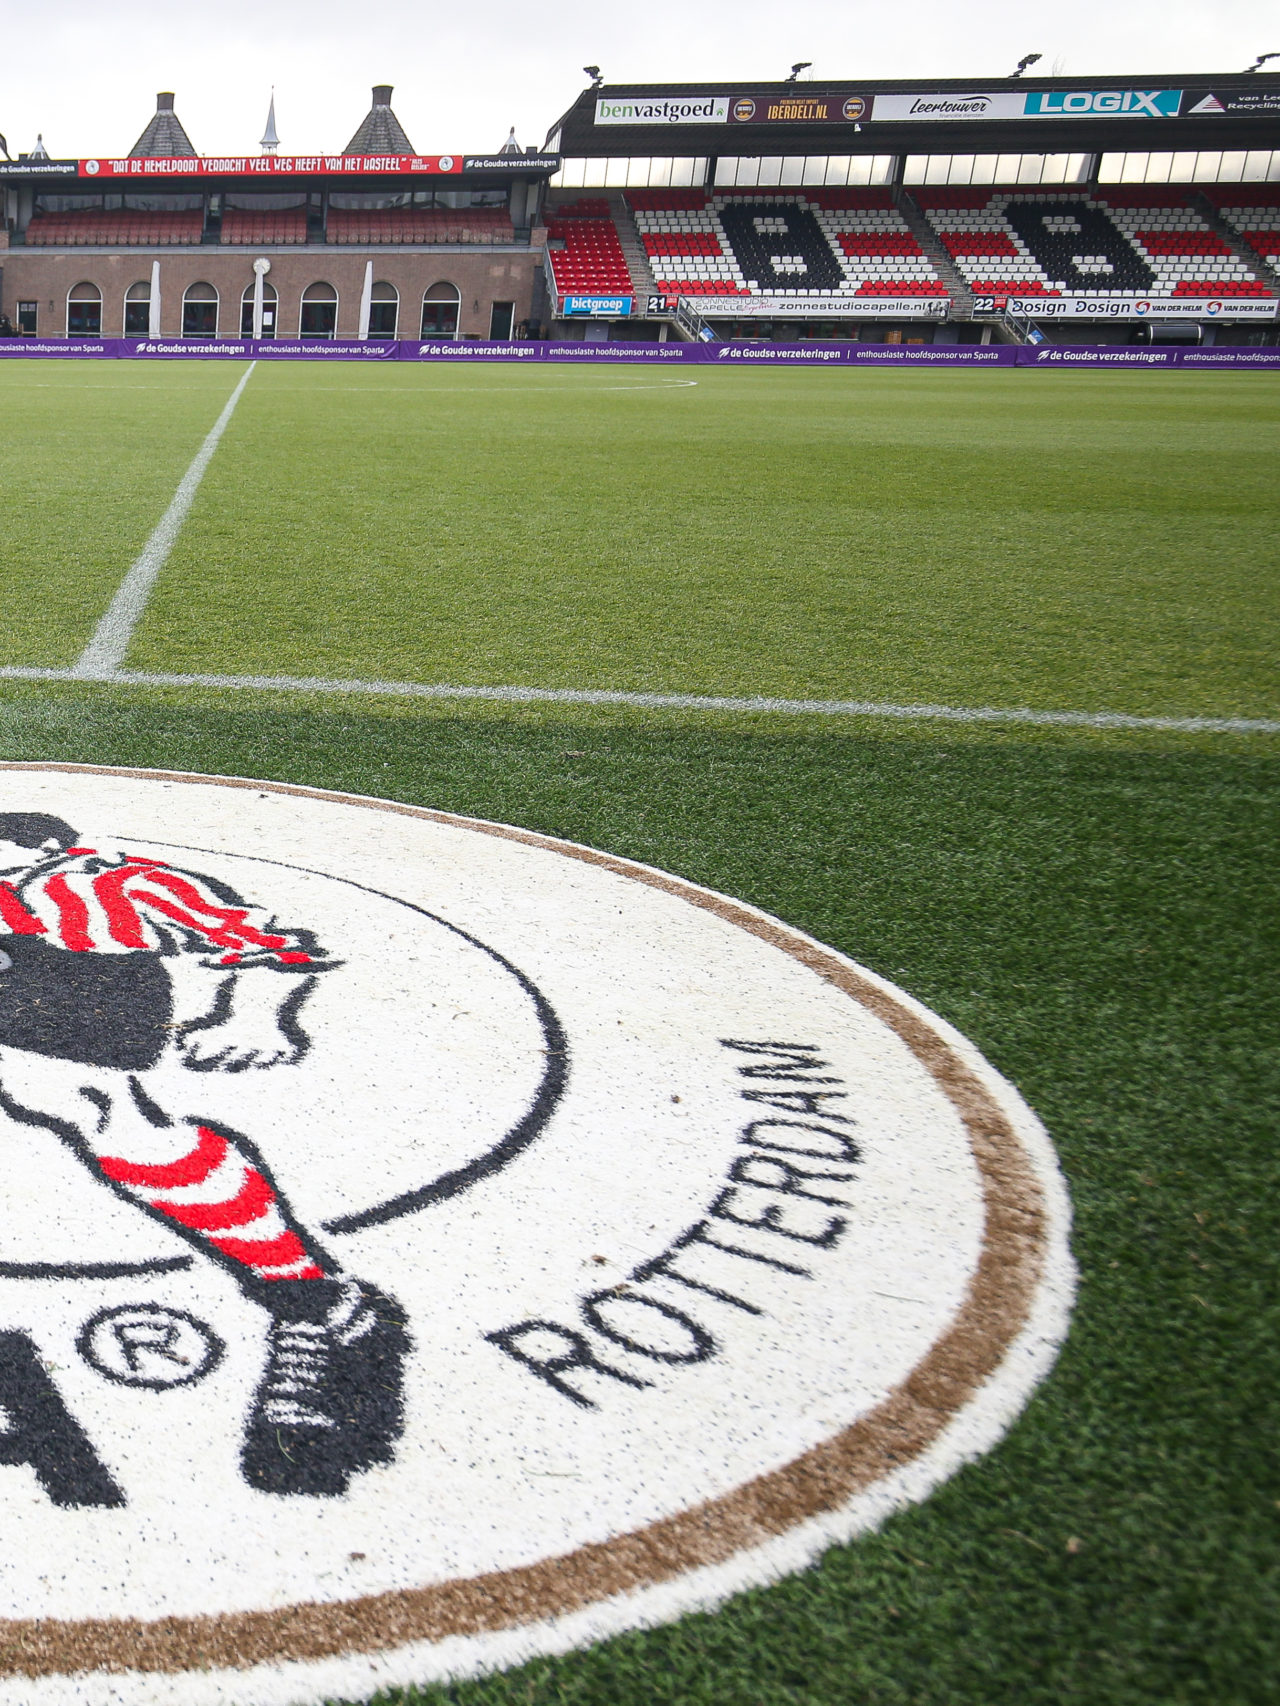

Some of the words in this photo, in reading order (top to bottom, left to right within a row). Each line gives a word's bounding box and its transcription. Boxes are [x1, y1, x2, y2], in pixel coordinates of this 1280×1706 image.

[909, 98, 988, 114] Leertouwer
[1039, 91, 1161, 115] LOGIX
[600, 99, 714, 123] benvastgoed
[767, 105, 828, 120] IBERDELI.NL
[131, 160, 142, 172] DE
[144, 160, 199, 172] HEMELPOORT
[202, 159, 246, 172] VERDACHT
[249, 159, 271, 171] VEEL
[273, 158, 293, 171] WEG
[295, 158, 321, 171] HEEFT
[324, 158, 343, 170] VAN
[344, 158, 361, 170] HET
[483, 160, 508, 168] Goudse
[508, 158, 557, 169] verzekeringen
[571, 297, 623, 310] bictgroep
[649, 297, 666, 309] 21
[778, 301, 926, 313] zonnestudiocapelle.nl
[975, 299, 993, 311] 22
[1012, 300, 1067, 316] Dosign
[1075, 300, 1131, 316] Dosign
[25, 344, 70, 353] hoofdsponsor
[82, 344, 104, 353] Sparta
[146, 344, 156, 353] de
[157, 344, 186, 353] Goudse
[187, 344, 245, 354] verzekeringen
[301, 346, 349, 354] hoofdsponsor
[362, 346, 385, 354] Sparta
[430, 346, 441, 355] de
[441, 346, 473, 355] Goudse
[473, 346, 534, 357] verzekeringen
[549, 347, 595, 355] enthousiaste
[595, 348, 644, 357] hoofdsponsor
[659, 348, 683, 357] Sparta
[730, 348, 741, 358] de
[742, 348, 776, 358] Goudse
[776, 349, 841, 360] verzekeringen
[856, 350, 904, 359] enthousiaste
[905, 351, 958, 361] hoofdsponsor
[973, 351, 998, 361] Sparta
[1050, 351, 1062, 360] de
[1063, 351, 1098, 361] Goudse
[1099, 351, 1167, 363] verzekeringen
[1183, 353, 1236, 361] enthousiaste
[483, 1037, 864, 1410] ROTTERDAM
